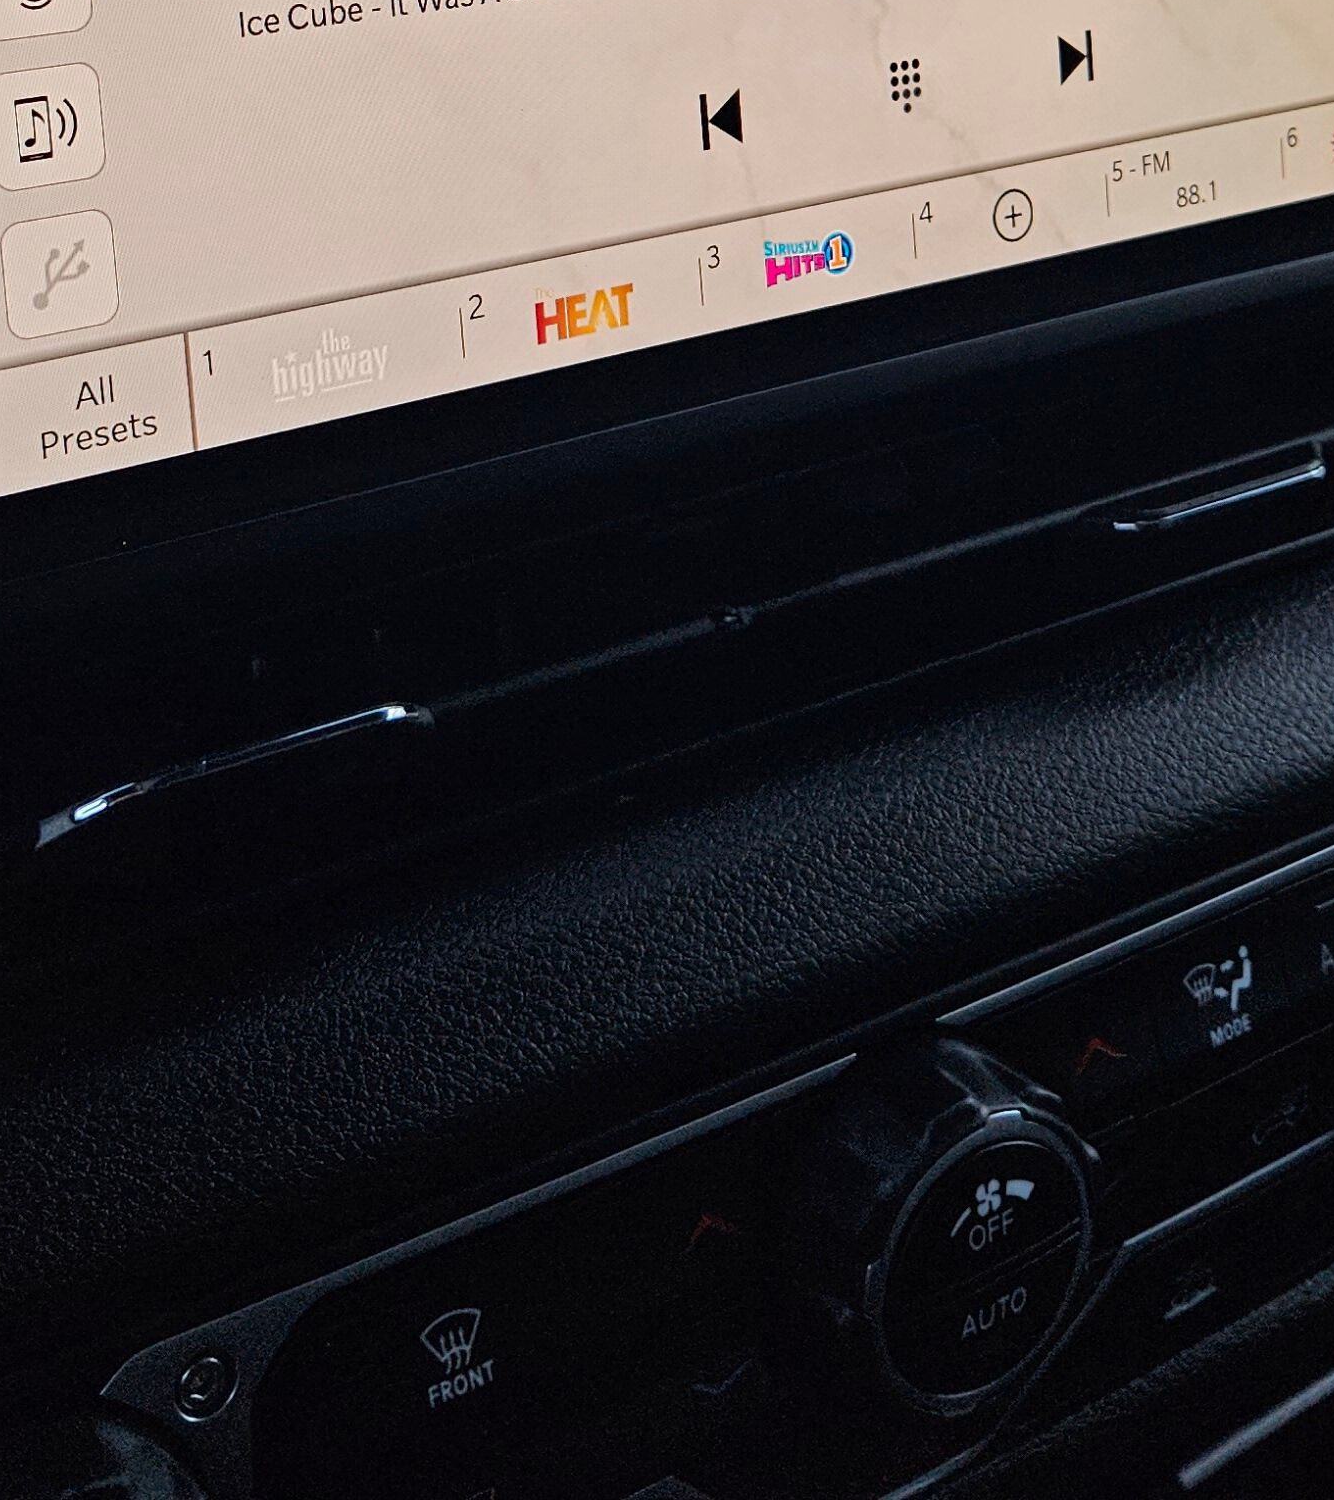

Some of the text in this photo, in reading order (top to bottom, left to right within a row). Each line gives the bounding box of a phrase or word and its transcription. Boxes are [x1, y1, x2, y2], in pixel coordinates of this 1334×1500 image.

[239, 11, 280, 37] Ice
[287, 0, 363, 32] Cube
[1287, 127, 1297, 147] 6
[1113, 160, 1123, 181] 5
[1142, 151, 1170, 175] FM
[1177, 180, 1215, 207] 88.1
[920, 202, 932, 224] 4
[707, 245, 720, 269] 3
[764, 235, 847, 288] HITS 1
[469, 294, 485, 320] 2
[536, 283, 633, 344] HEAT
[322, 329, 350, 356] the
[203, 350, 214, 375] 1
[272, 345, 388, 397] highway
[75, 376, 115, 409] All
[41, 413, 158, 459] Presets
[1210, 1013, 1253, 1048] MODE
[969, 1207, 1014, 1251] OFF
[961, 1286, 1027, 1340] AUTO
[428, 1359, 495, 1409] FRONT
